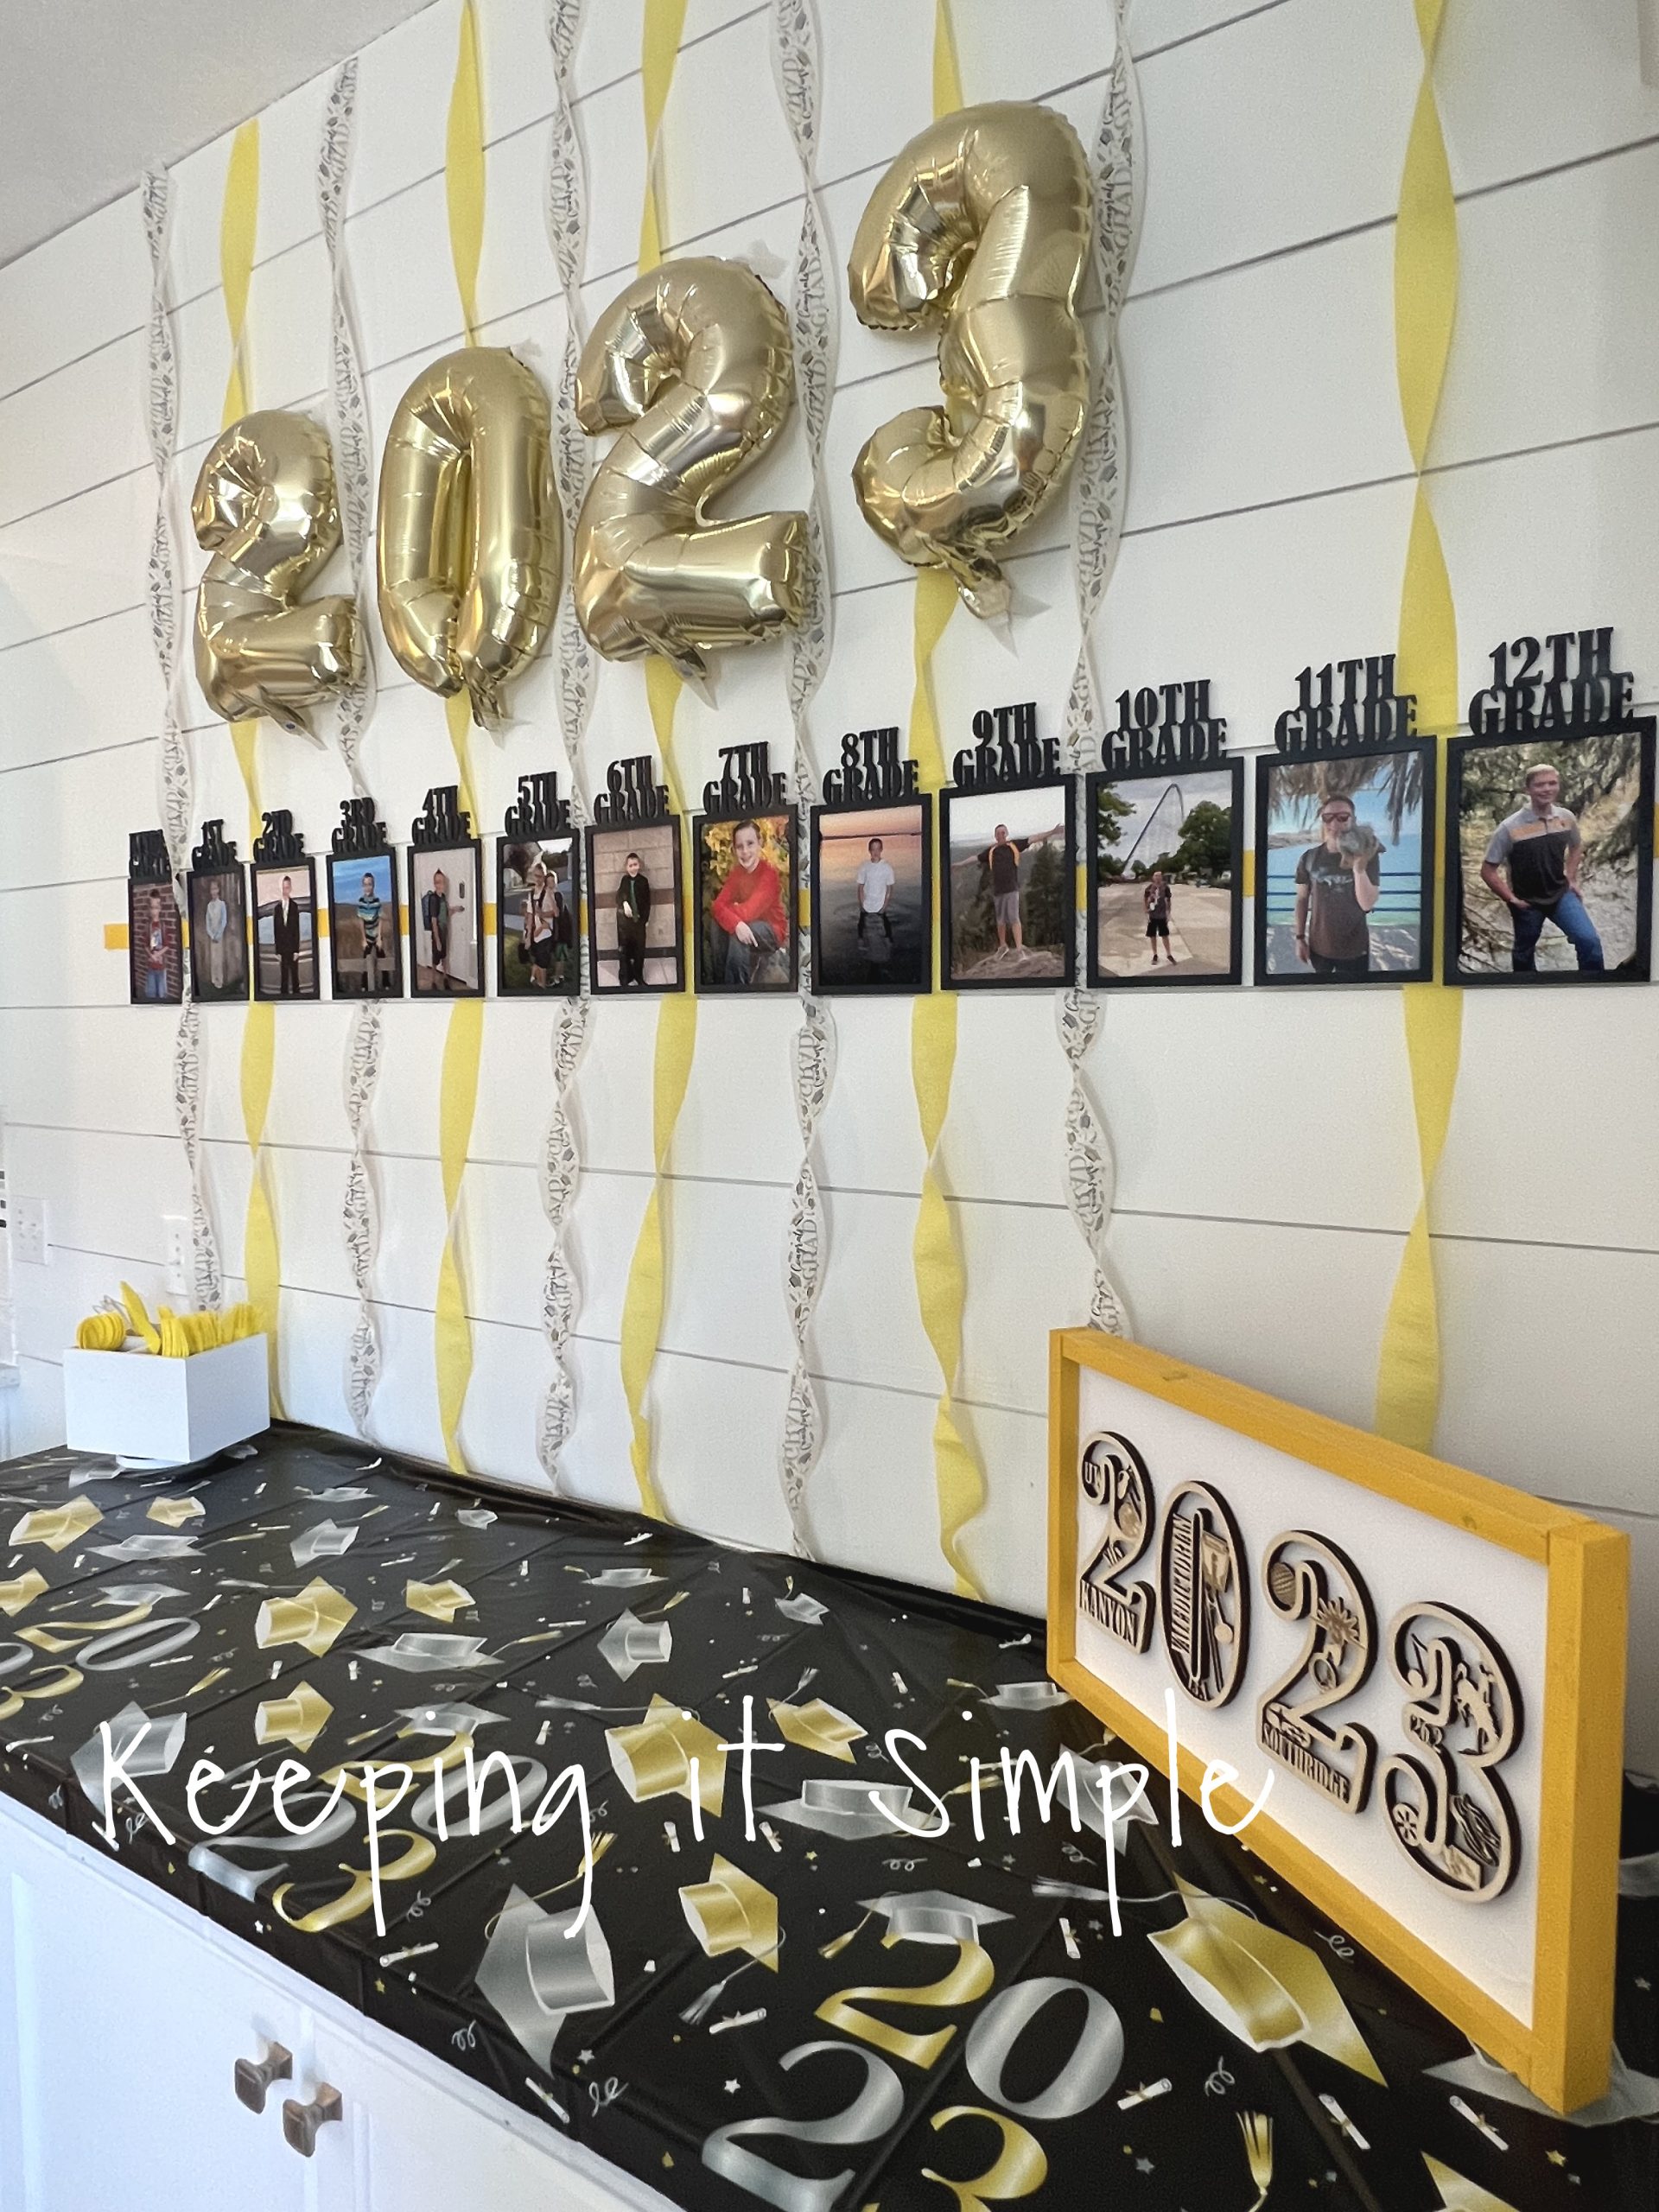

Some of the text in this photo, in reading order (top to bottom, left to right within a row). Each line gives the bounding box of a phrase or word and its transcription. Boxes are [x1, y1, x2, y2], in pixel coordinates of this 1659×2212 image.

[191, 99, 1095, 722] 2023
[1489, 626, 1613, 690] 12TH
[1295, 654, 1395, 709] 11TH
[972, 702, 1037, 747] 9TH
[1116, 679, 1211, 731] 10TH
[1274, 695, 1417, 753] GRADE
[1469, 671, 1634, 736] GRADE
[719, 741, 769, 779] 7TH
[840, 727, 899, 768] 8TH
[953, 737, 1061, 788] GRADE
[1101, 718, 1227, 772] GRADE
[518, 771, 556, 804] 5TH
[607, 755, 652, 793] 6TH
[702, 772, 787, 814] GRADE
[823, 760, 918, 804] GRADE
[340, 797, 375, 822] 3RD
[422, 785, 458, 817] 4TH
[505, 799, 571, 835] GRADE
[594, 785, 670, 823] GRADE
[332, 822, 387, 852] GRADE
[412, 811, 474, 843] GRADE
[1077, 1431, 1524, 1902] 2023
